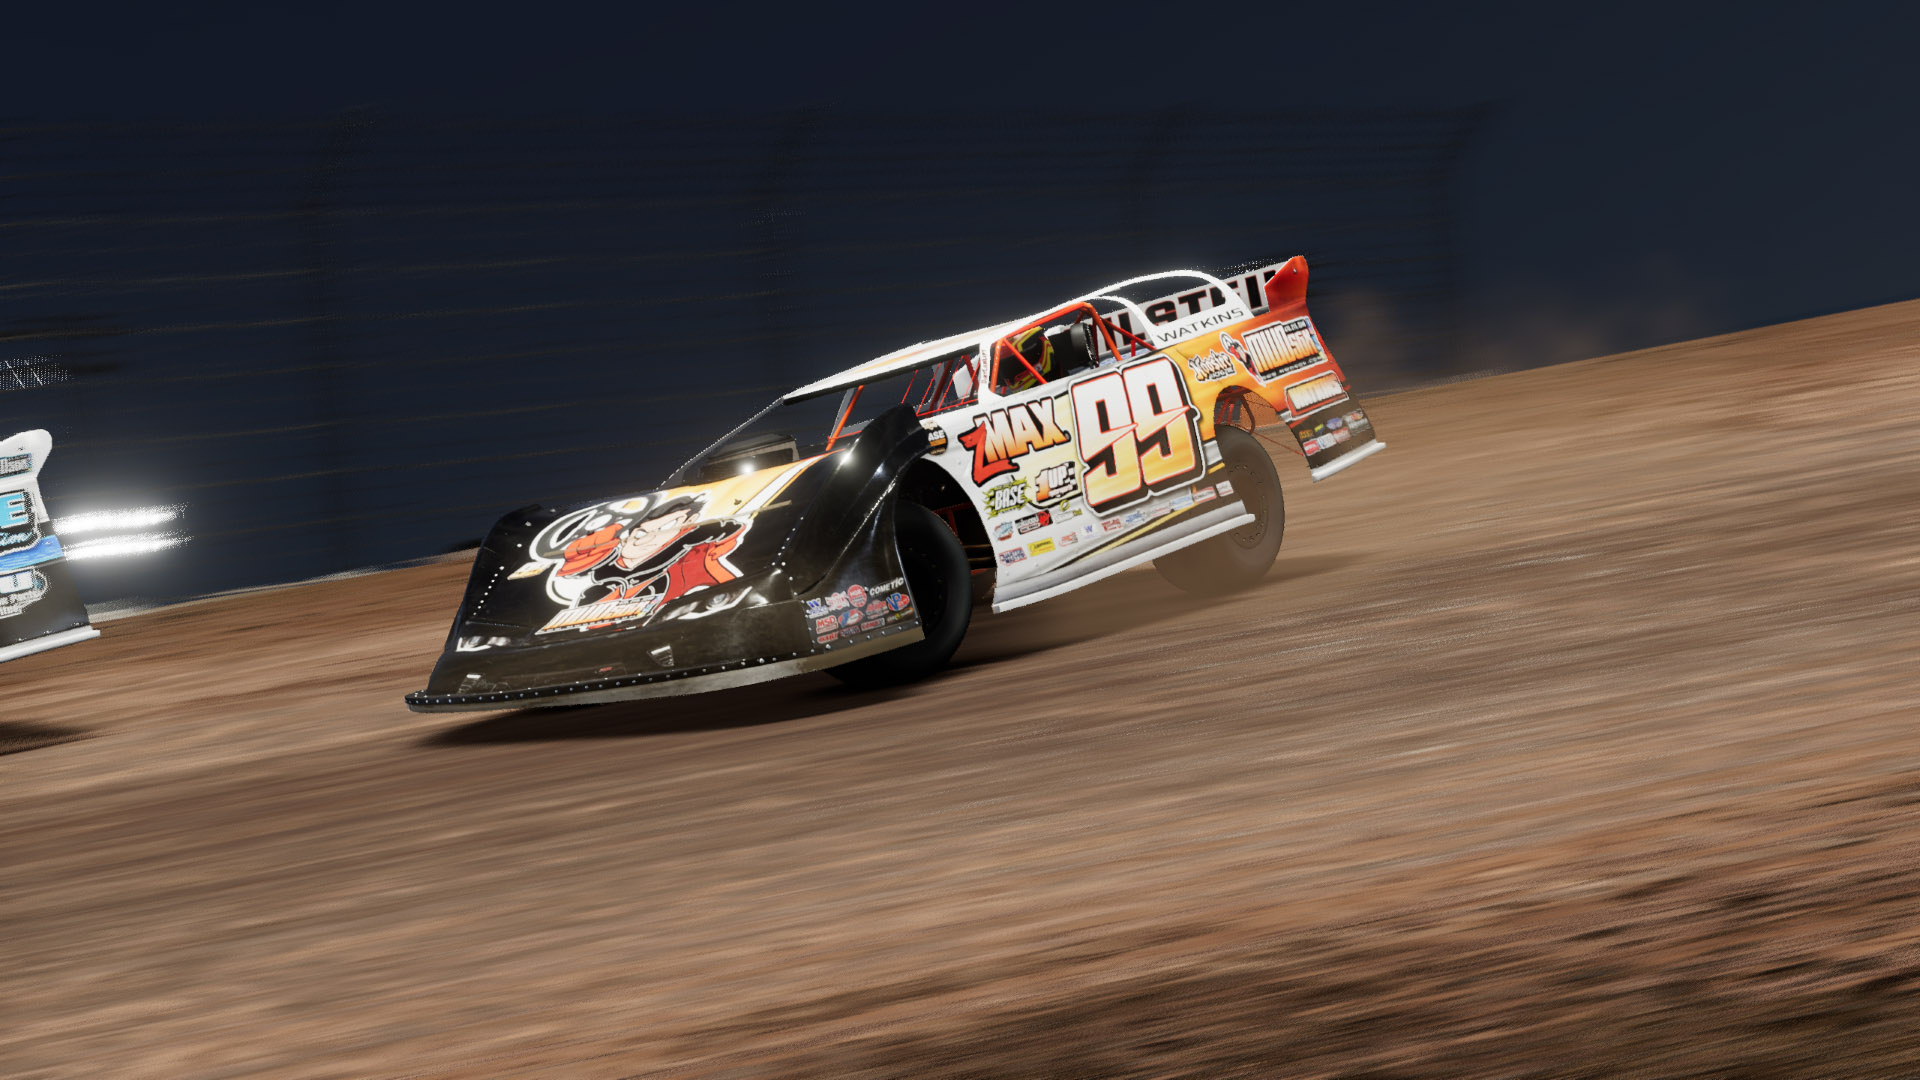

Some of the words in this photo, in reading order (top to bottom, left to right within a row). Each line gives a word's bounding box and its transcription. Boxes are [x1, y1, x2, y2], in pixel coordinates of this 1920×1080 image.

[1157, 307, 1244, 342] WATKINS
[1070, 359, 1198, 509] 99
[994, 483, 1026, 511] BASE
[869, 577, 904, 596] COMETIC
[886, 592, 902, 611] VP
[816, 615, 836, 627] MSD
